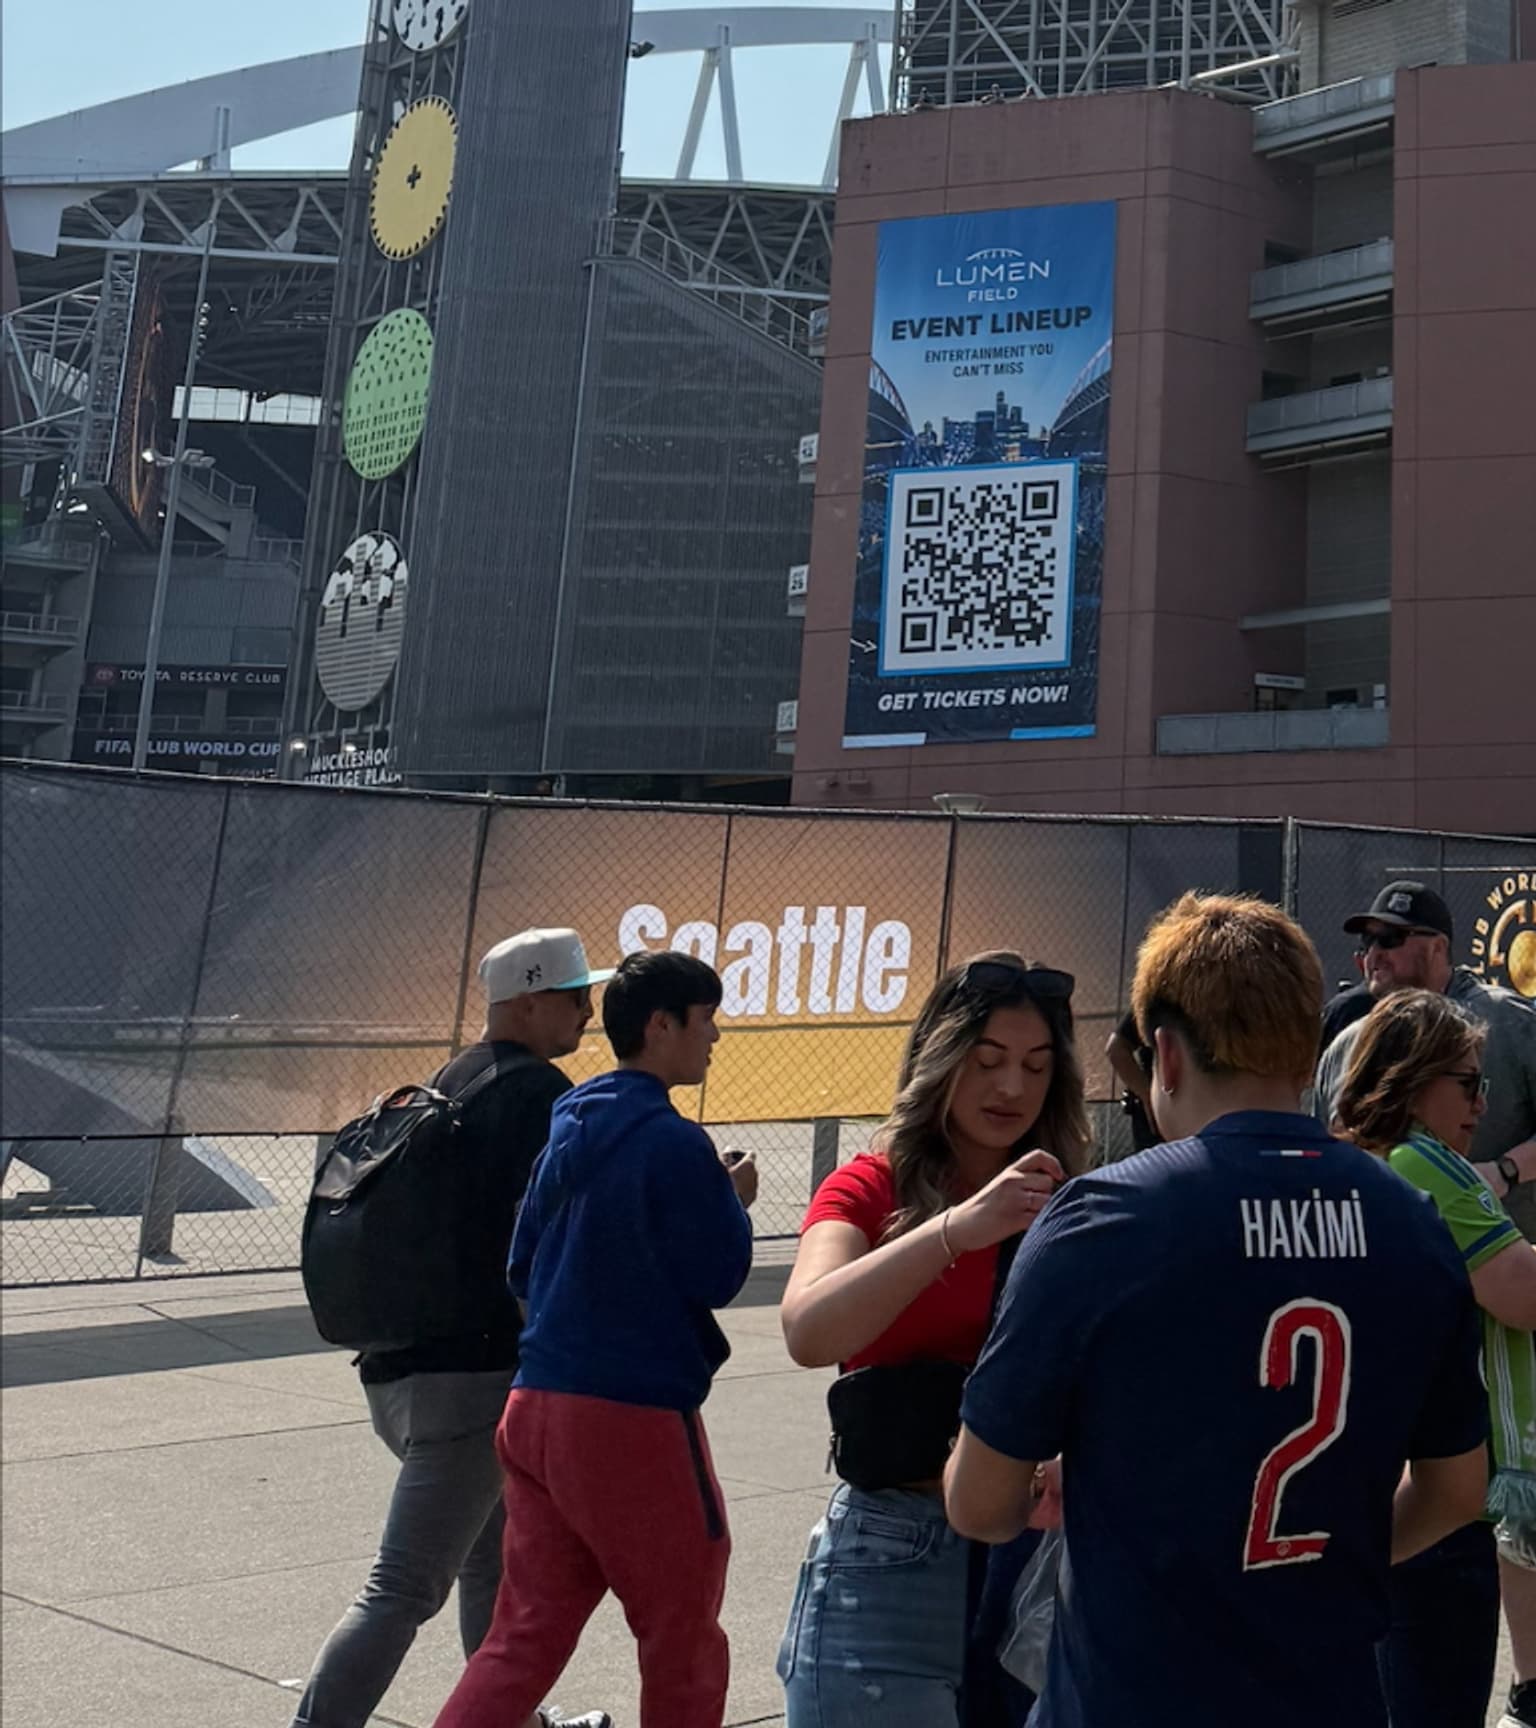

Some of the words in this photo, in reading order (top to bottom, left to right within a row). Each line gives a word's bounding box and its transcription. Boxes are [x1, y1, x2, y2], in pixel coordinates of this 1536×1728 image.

[936, 259, 1050, 288] LUMEN
[967, 287, 1018, 303] FIELD
[891, 314, 983, 341] EVENT
[990, 306, 1092, 334] LINEUP
[924, 345, 1026, 363] ENTERTAINMENT
[1028, 343, 1054, 359] YOU
[953, 364, 991, 378] CAN'T
[993, 362, 1025, 376] MISS
[120, 670, 171, 682] TOYTA
[180, 671, 239, 682] RESERVE
[245, 673, 281, 684] CLUB
[878, 693, 918, 711] GET
[923, 688, 1006, 709] TICKETS
[1011, 685, 1069, 705] NOW!
[95, 740, 132, 754] FIFA
[146, 740, 179, 755] LUB
[183, 741, 245, 756] WORLD
[249, 742, 281, 756] CUP
[1244, 1297, 1351, 1571] 2
